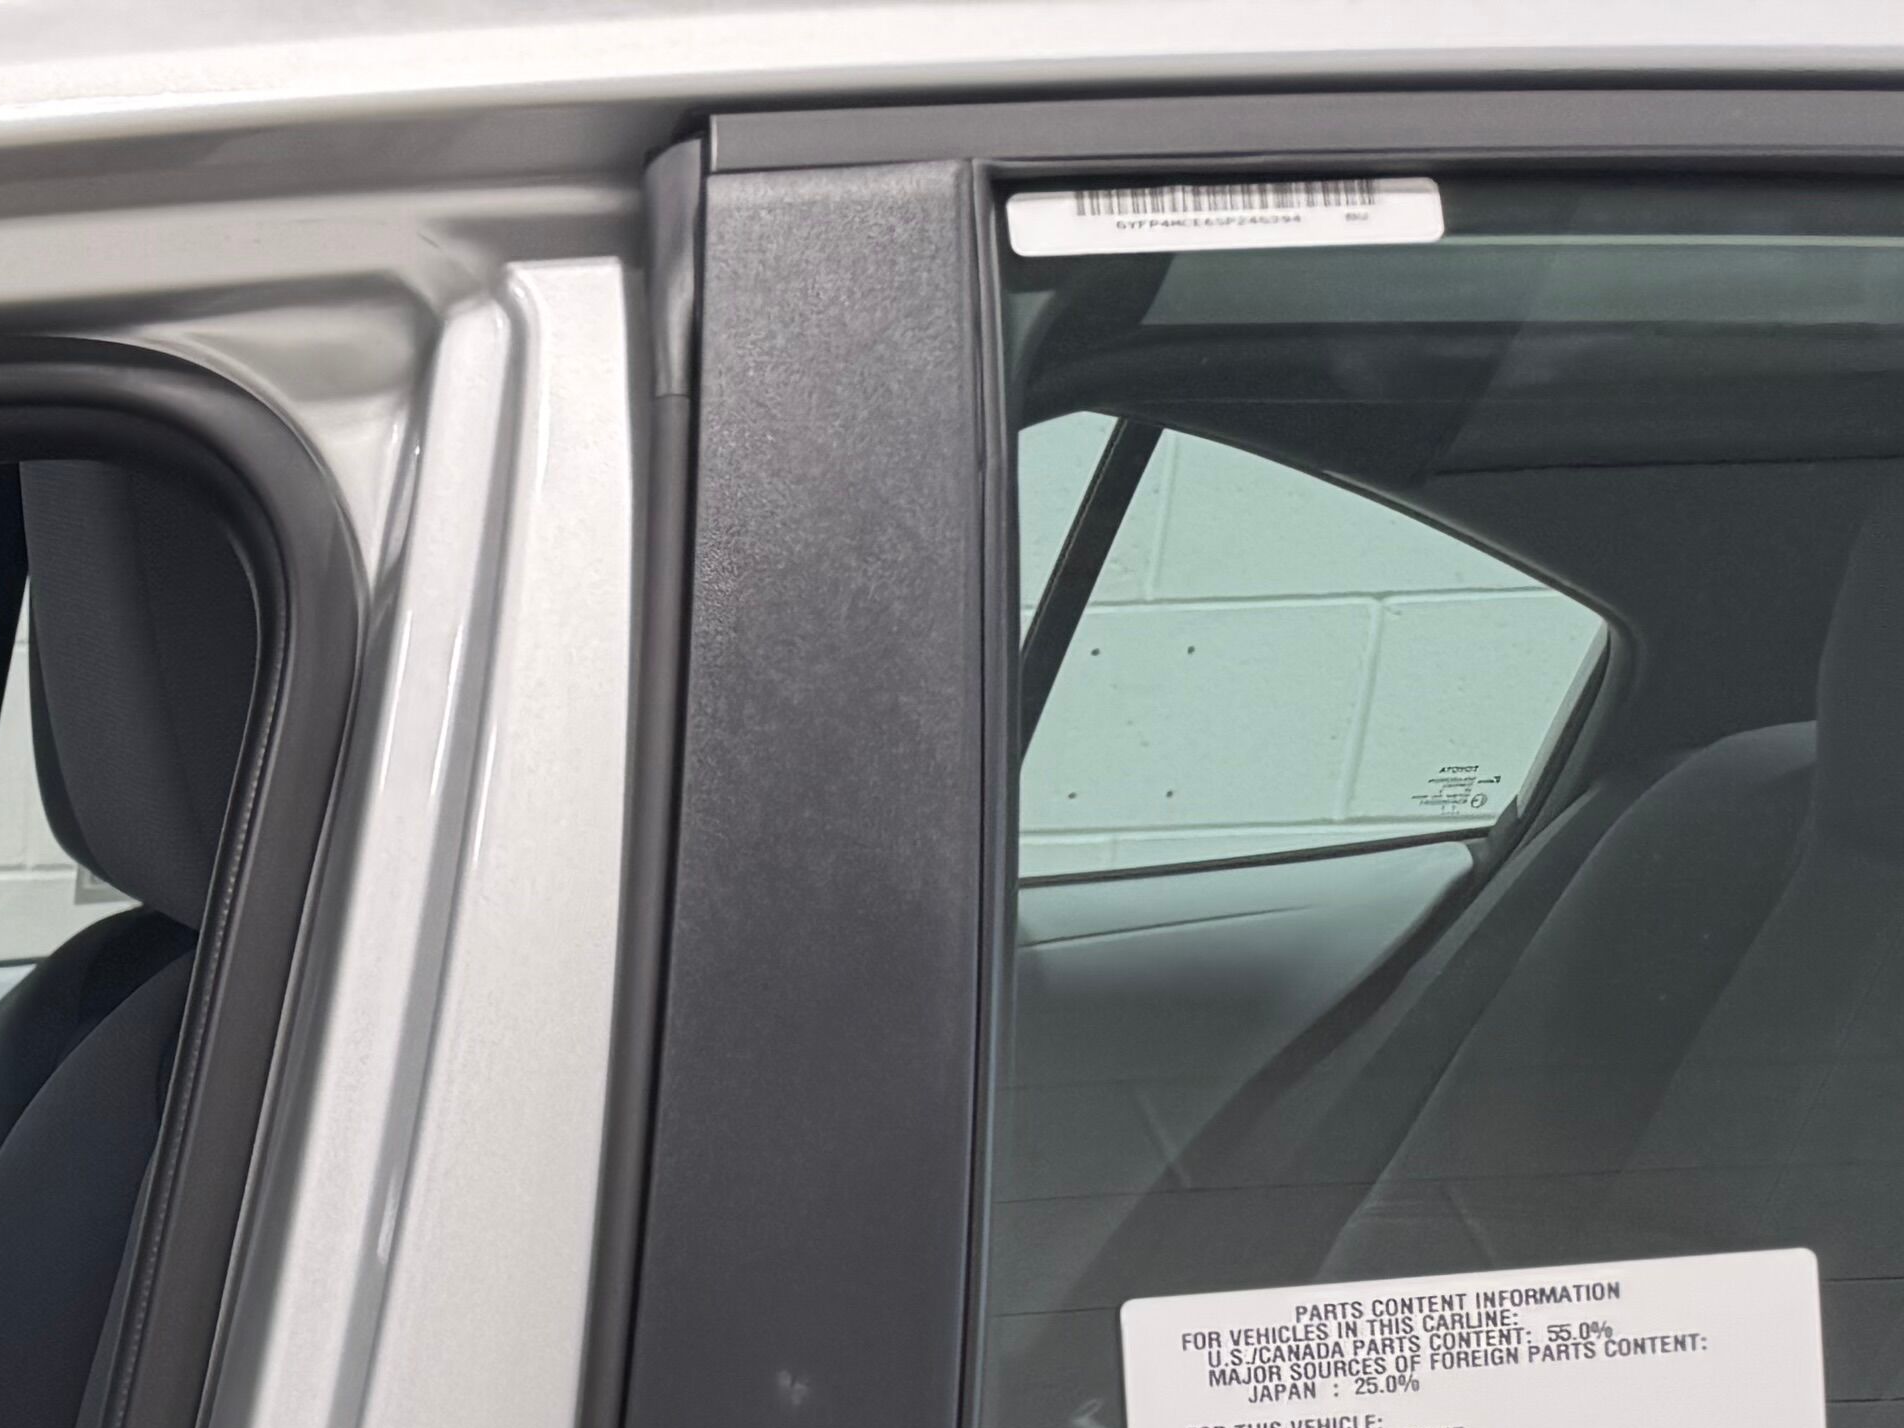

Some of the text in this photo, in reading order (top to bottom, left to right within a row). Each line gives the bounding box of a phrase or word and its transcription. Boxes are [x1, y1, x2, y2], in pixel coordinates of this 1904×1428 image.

[1295, 1281, 1620, 1323] PARTS CONTENT INFORMATION
[1181, 1308, 1518, 1351] FOR VEHICLES IN THIS CARLINE:
[1207, 1321, 1613, 1368] U.S./CANADA PARTS CONTENT: 55.0%
[1208, 1332, 1707, 1387] MAJOR SOURCES OF FOREIGN PARTS CONTENT:
[1248, 1381, 1316, 1404] JAPAN
[1354, 1373, 1420, 1395] 25.0%
